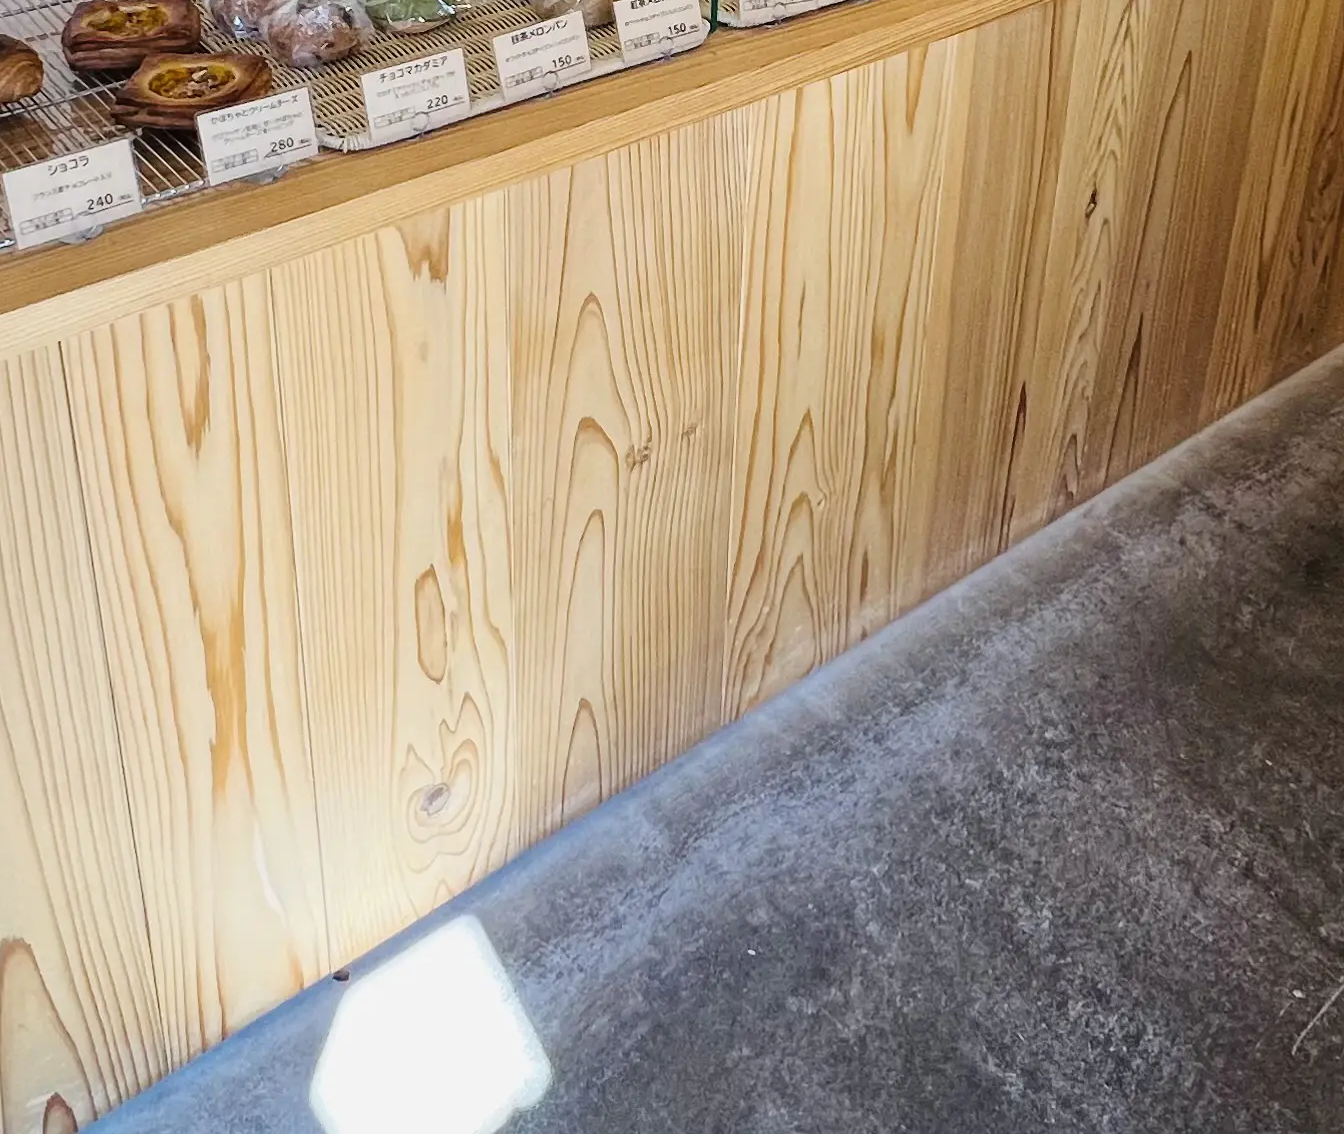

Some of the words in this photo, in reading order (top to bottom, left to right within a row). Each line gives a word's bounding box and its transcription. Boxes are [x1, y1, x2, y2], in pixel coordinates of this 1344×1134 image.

[668, 22, 687, 35] 150
[552, 54, 572, 68] 150
[379, 55, 448, 84] チョコマカダミア
[427, 95, 449, 109] 220
[270, 137, 294, 153] 280
[47, 155, 90, 177] ショコラ
[86, 193, 114, 211] 240
